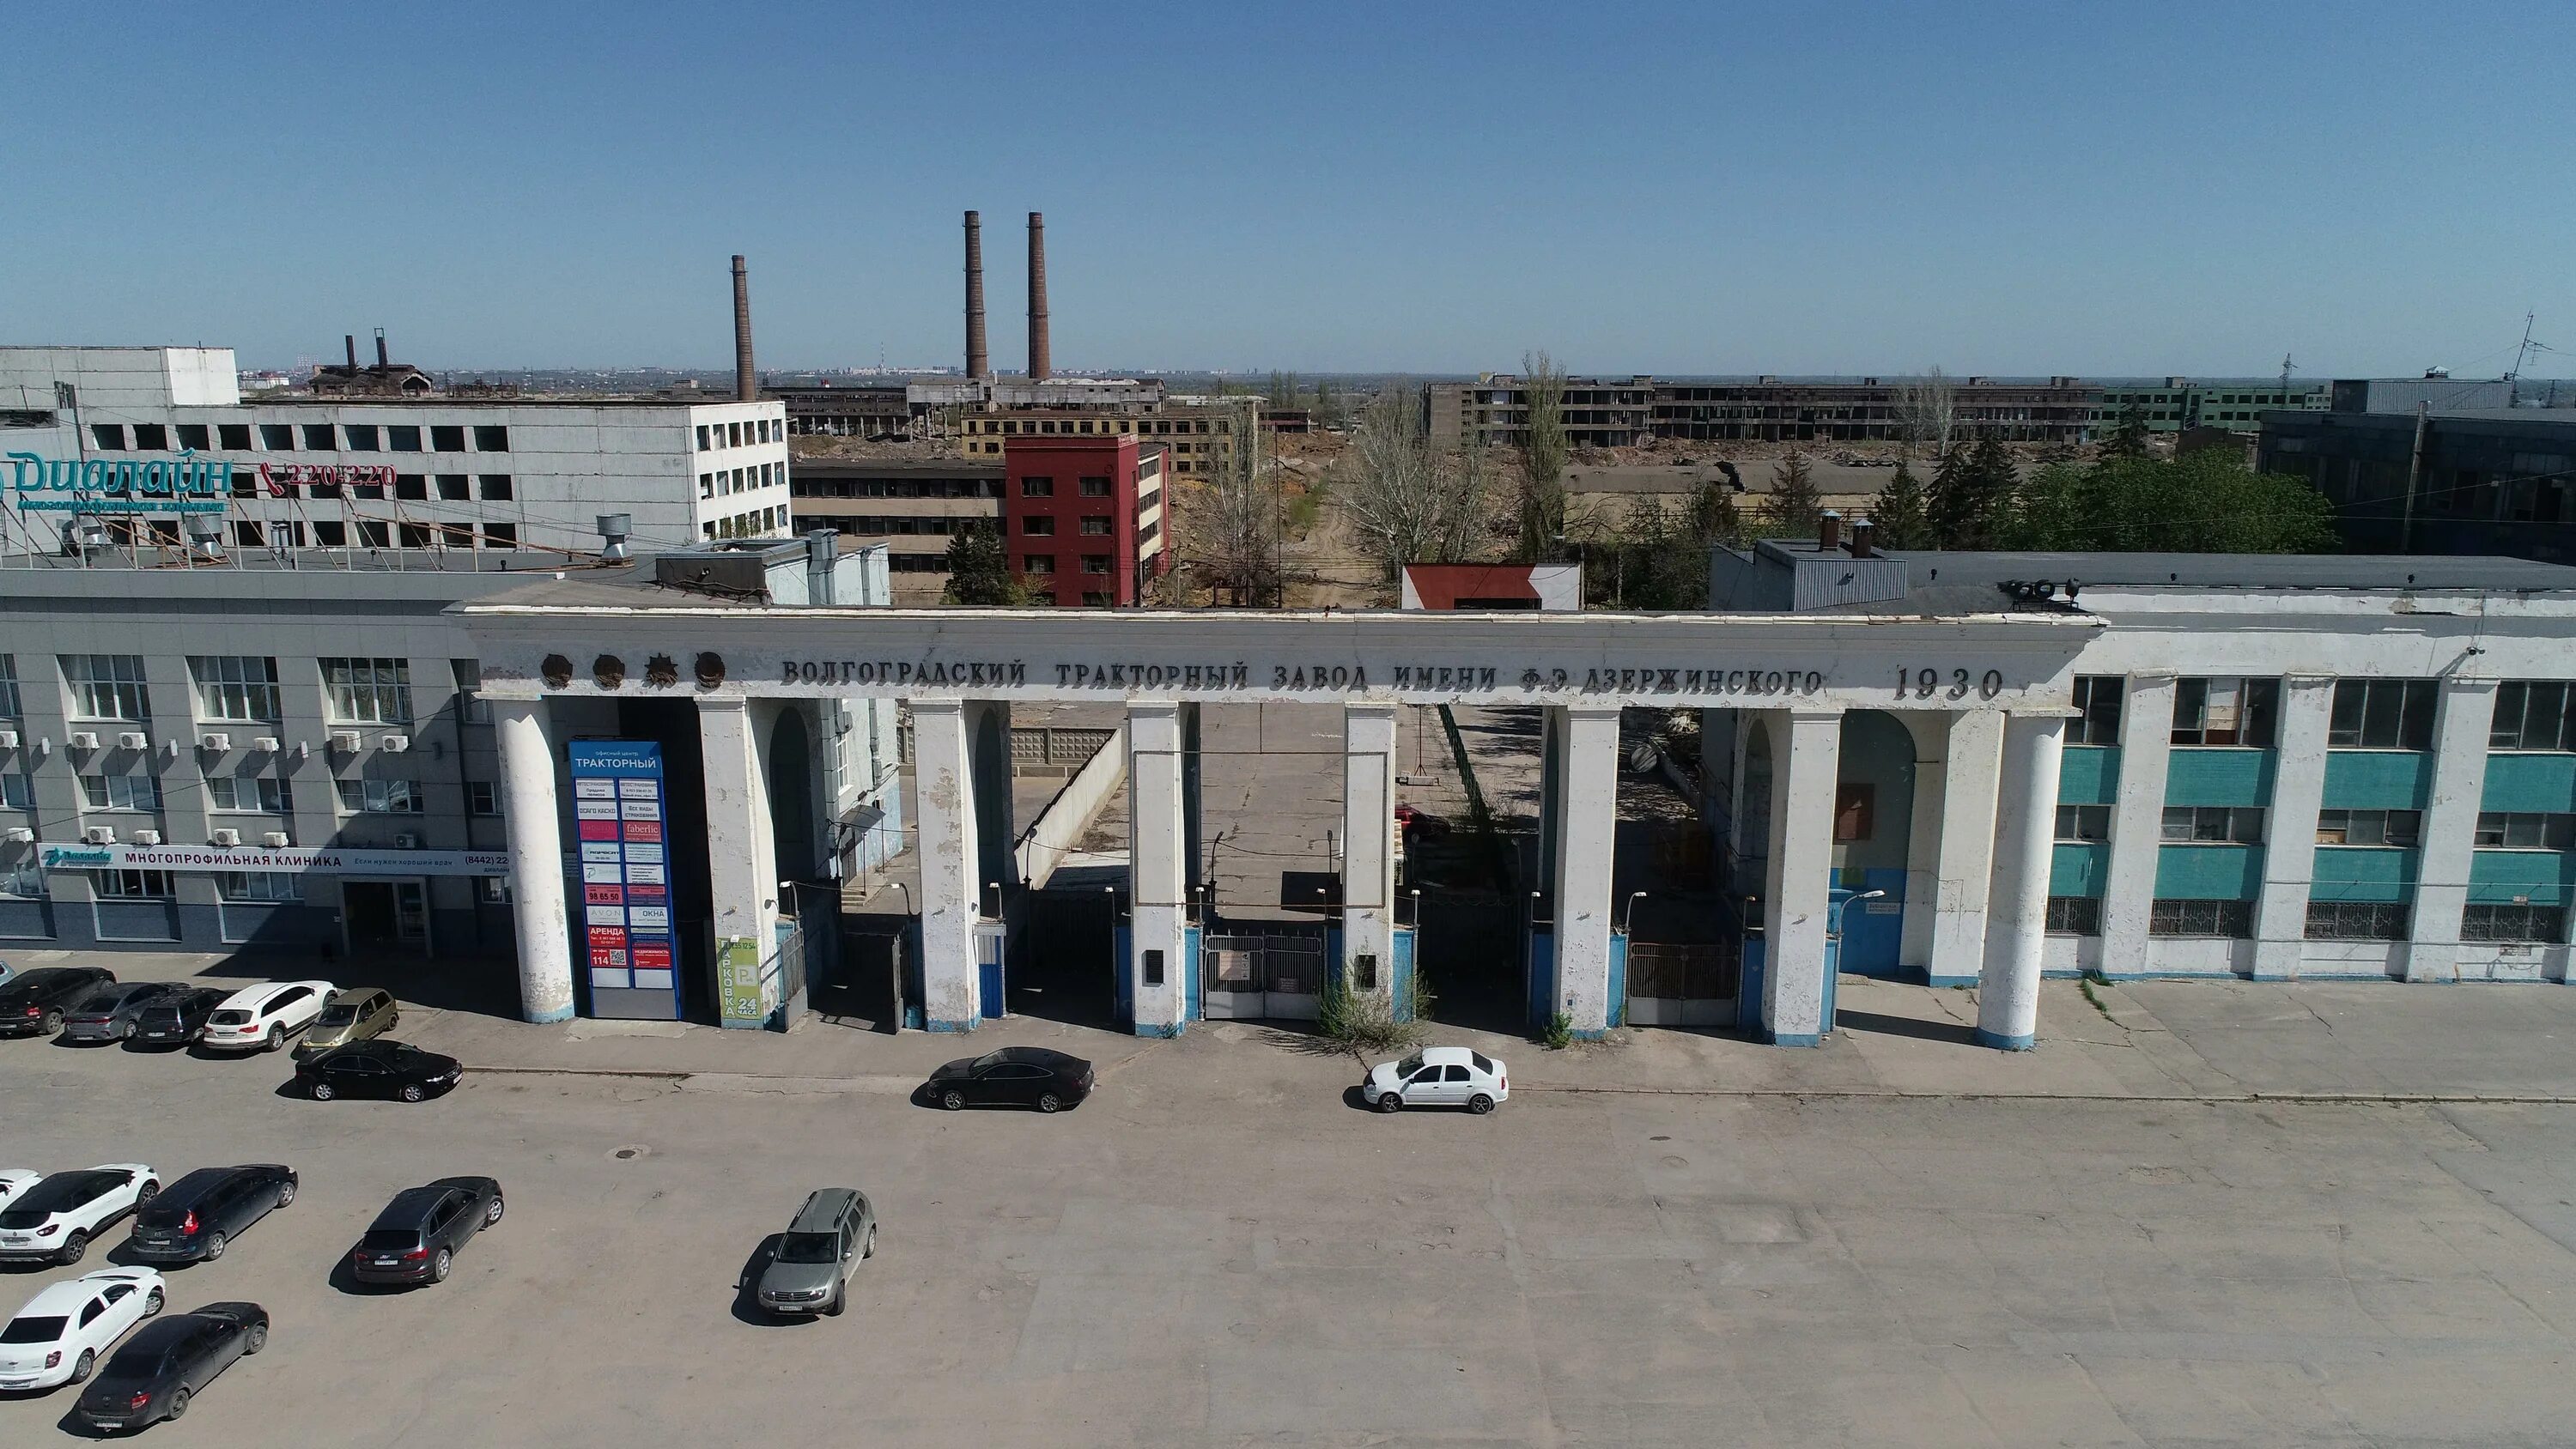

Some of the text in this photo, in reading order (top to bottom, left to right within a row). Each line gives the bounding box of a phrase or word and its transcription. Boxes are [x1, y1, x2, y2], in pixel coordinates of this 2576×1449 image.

[7, 447, 233, 493] Диалайн
[287, 464, 397, 487] 220-220
[782, 659, 1026, 687] ВОЛГОГРАДСКИЙ
[1055, 661, 1248, 688] ТРАКТОРНЫЙ
[1273, 666, 1369, 690] ЗАВОД
[1394, 667, 1497, 688] ИМЕНИ
[1582, 669, 1822, 692] ДЗЕРЖИНСКОГО
[1895, 667, 2002, 697] 1930
[575, 757, 656, 768] ТРАКТОРНЫЙ
[627, 824, 659, 834] faberlic
[125, 852, 342, 867] МНОГОПРОФИЛЬНАЯ КЛИНИКА
[465, 856, 494, 865] (8442)
[590, 927, 625, 936] АРЕНДА
[592, 955, 609, 964] 114
[720, 940, 735, 1016] ПАРКОВКА
[738, 997, 756, 1009] 24
